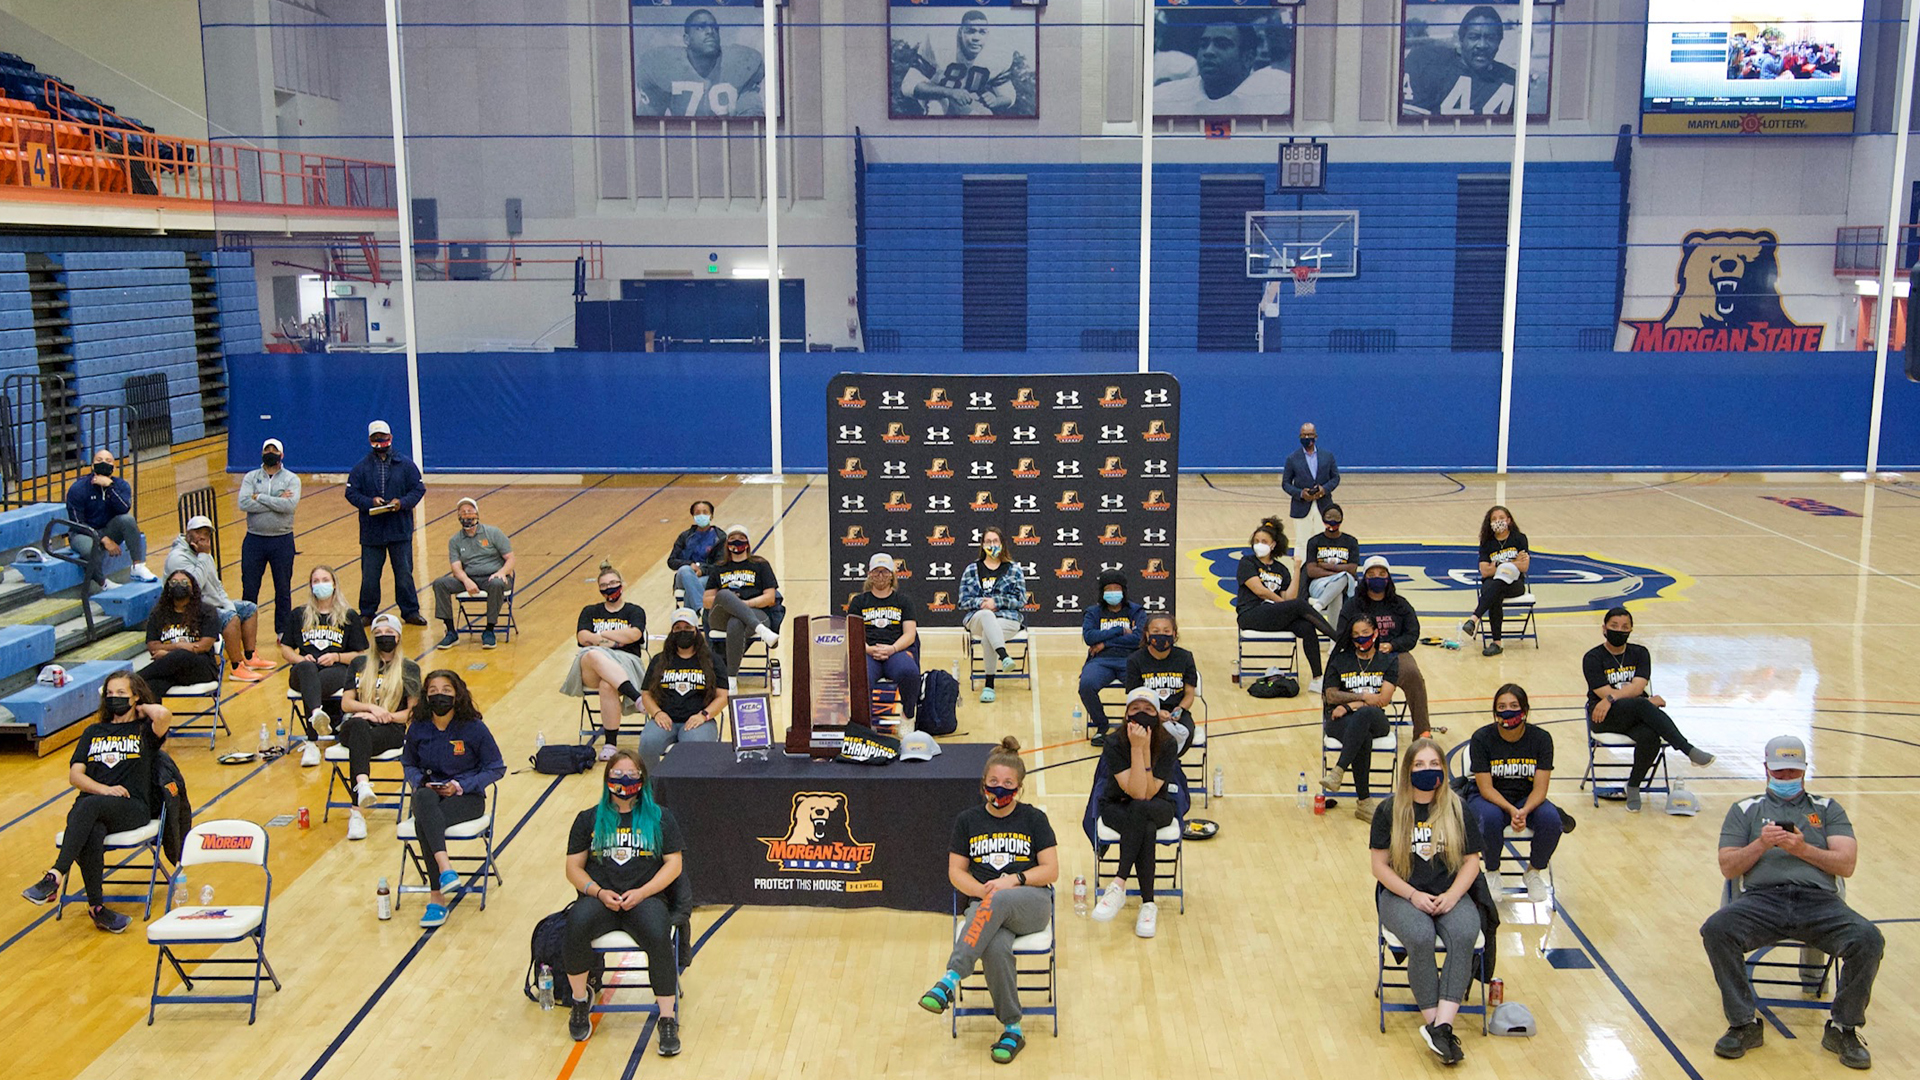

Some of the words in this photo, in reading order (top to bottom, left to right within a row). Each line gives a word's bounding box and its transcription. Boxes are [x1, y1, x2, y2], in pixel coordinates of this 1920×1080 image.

[939, 62, 991, 93] 80
[671, 81, 738, 116] 79
[1687, 119, 1740, 129] MARYLAND
[1762, 118, 1805, 129] LOTTERY
[1211, 125, 1225, 138] 5
[35, 148, 46, 182] 4
[1633, 322, 1749, 351] MORGAN
[1748, 321, 1821, 351] STATE
[863, 610, 901, 621] CHAMPIONS
[816, 635, 844, 643] MEAC
[1490, 764, 1536, 777] HAMPION
[202, 834, 253, 849] MORGAN
[969, 837, 1031, 856] CHAMPIONS
[768, 841, 832, 860] MORGAN
[831, 841, 872, 861] STATE
[790, 861, 851, 869] BEARS
[754, 878, 795, 890] PROTECT
[796, 879, 812, 891] THIS
[812, 880, 844, 892] HOUSE
